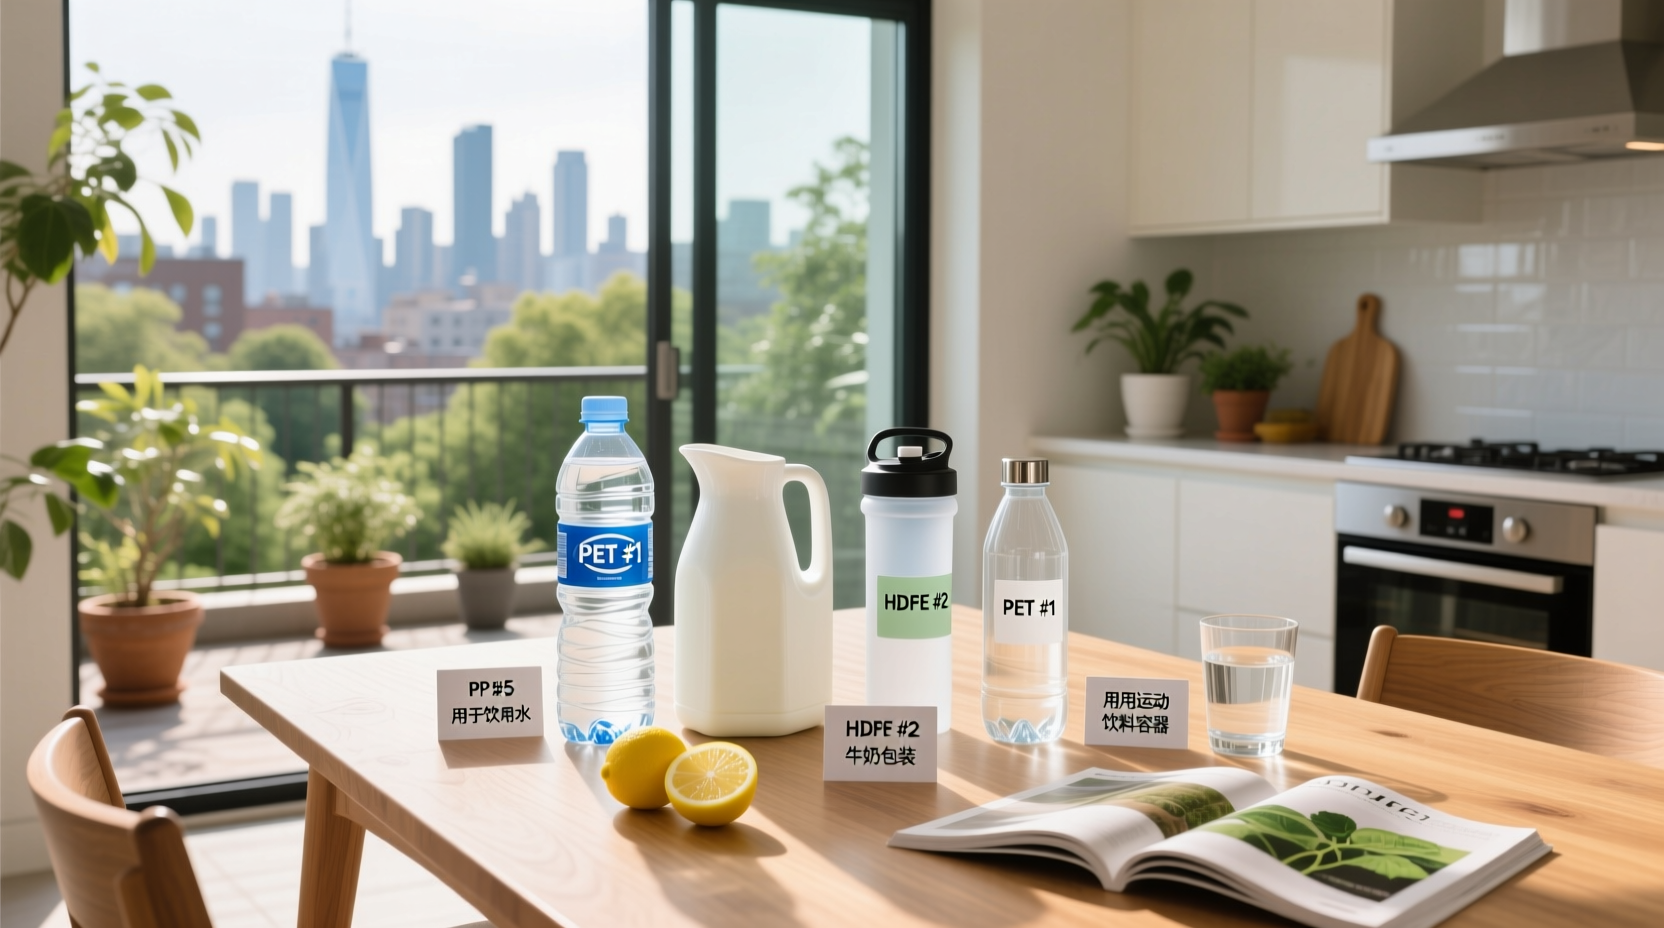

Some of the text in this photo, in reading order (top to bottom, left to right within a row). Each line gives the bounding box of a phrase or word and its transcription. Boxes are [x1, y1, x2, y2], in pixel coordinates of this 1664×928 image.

[578, 541, 642, 564] PET #1
[932, 591, 949, 611] #2
[1003, 598, 1055, 617] PET #1
[469, 679, 515, 697] PP #5
[1103, 691, 1170, 710] 用用运动
[451, 704, 532, 725] 用于饮用水
[1101, 712, 1169, 734] 饮料容器
[897, 720, 920, 737] #2
[845, 745, 917, 766] 牛奶包装
